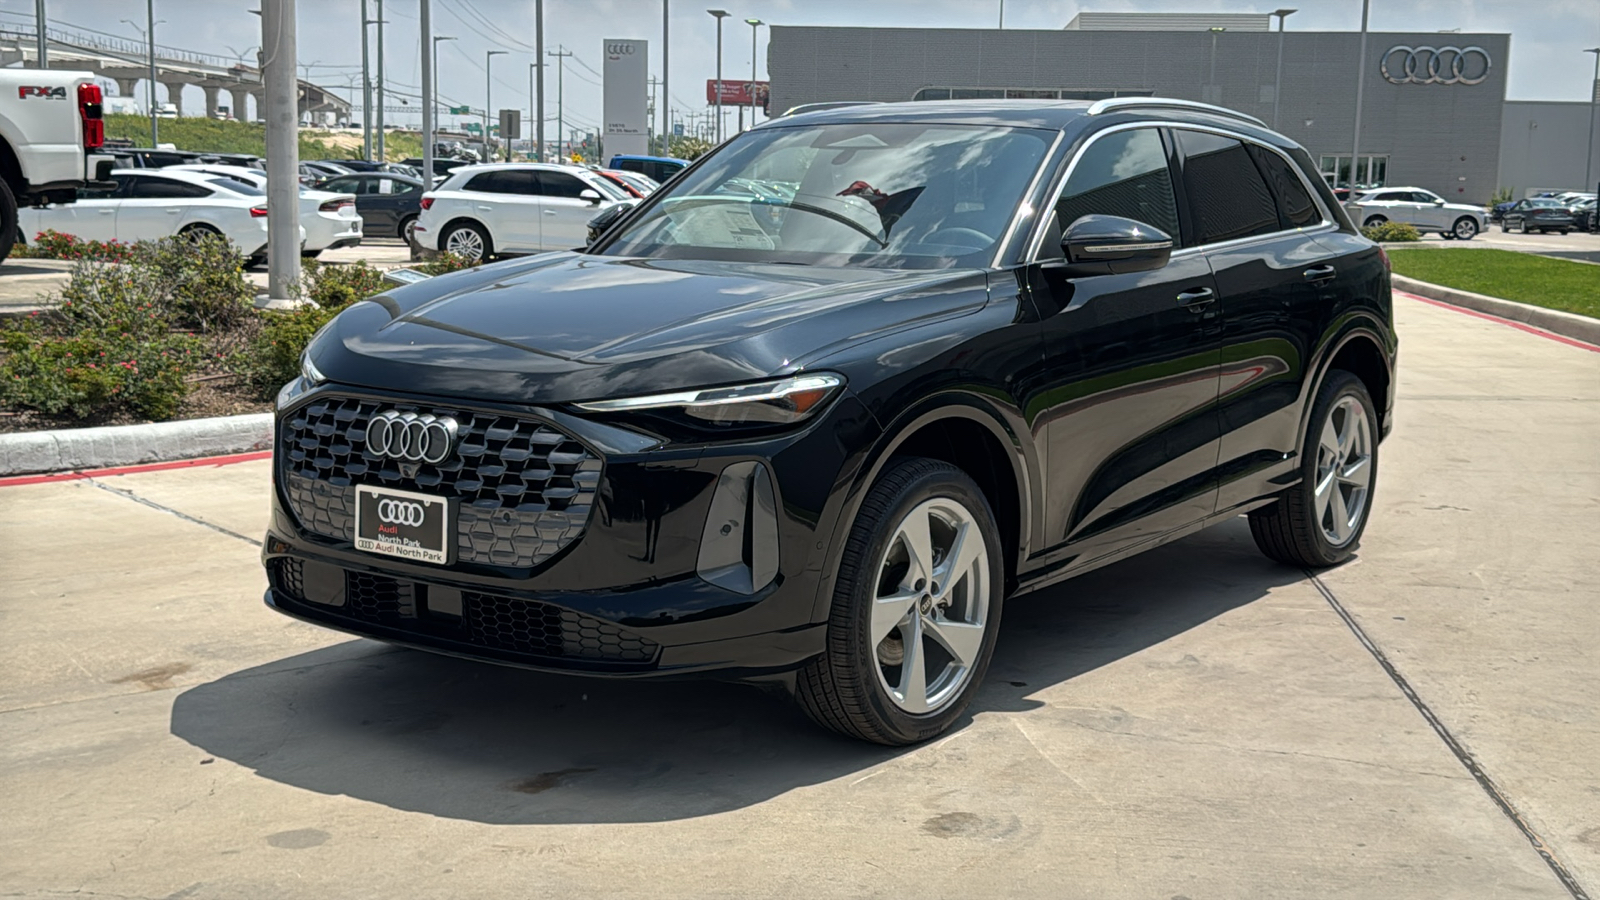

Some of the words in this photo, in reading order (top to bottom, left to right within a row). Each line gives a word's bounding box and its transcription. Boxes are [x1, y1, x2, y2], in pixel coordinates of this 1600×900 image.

[18, 86, 67, 99] FX4
[378, 524, 398, 534] Audi
[378, 534, 402, 544] North
[403, 538, 421, 548] Park
[375, 543, 395, 553] Audi
[396, 546, 421, 558] North
[423, 551, 442, 561] Park
